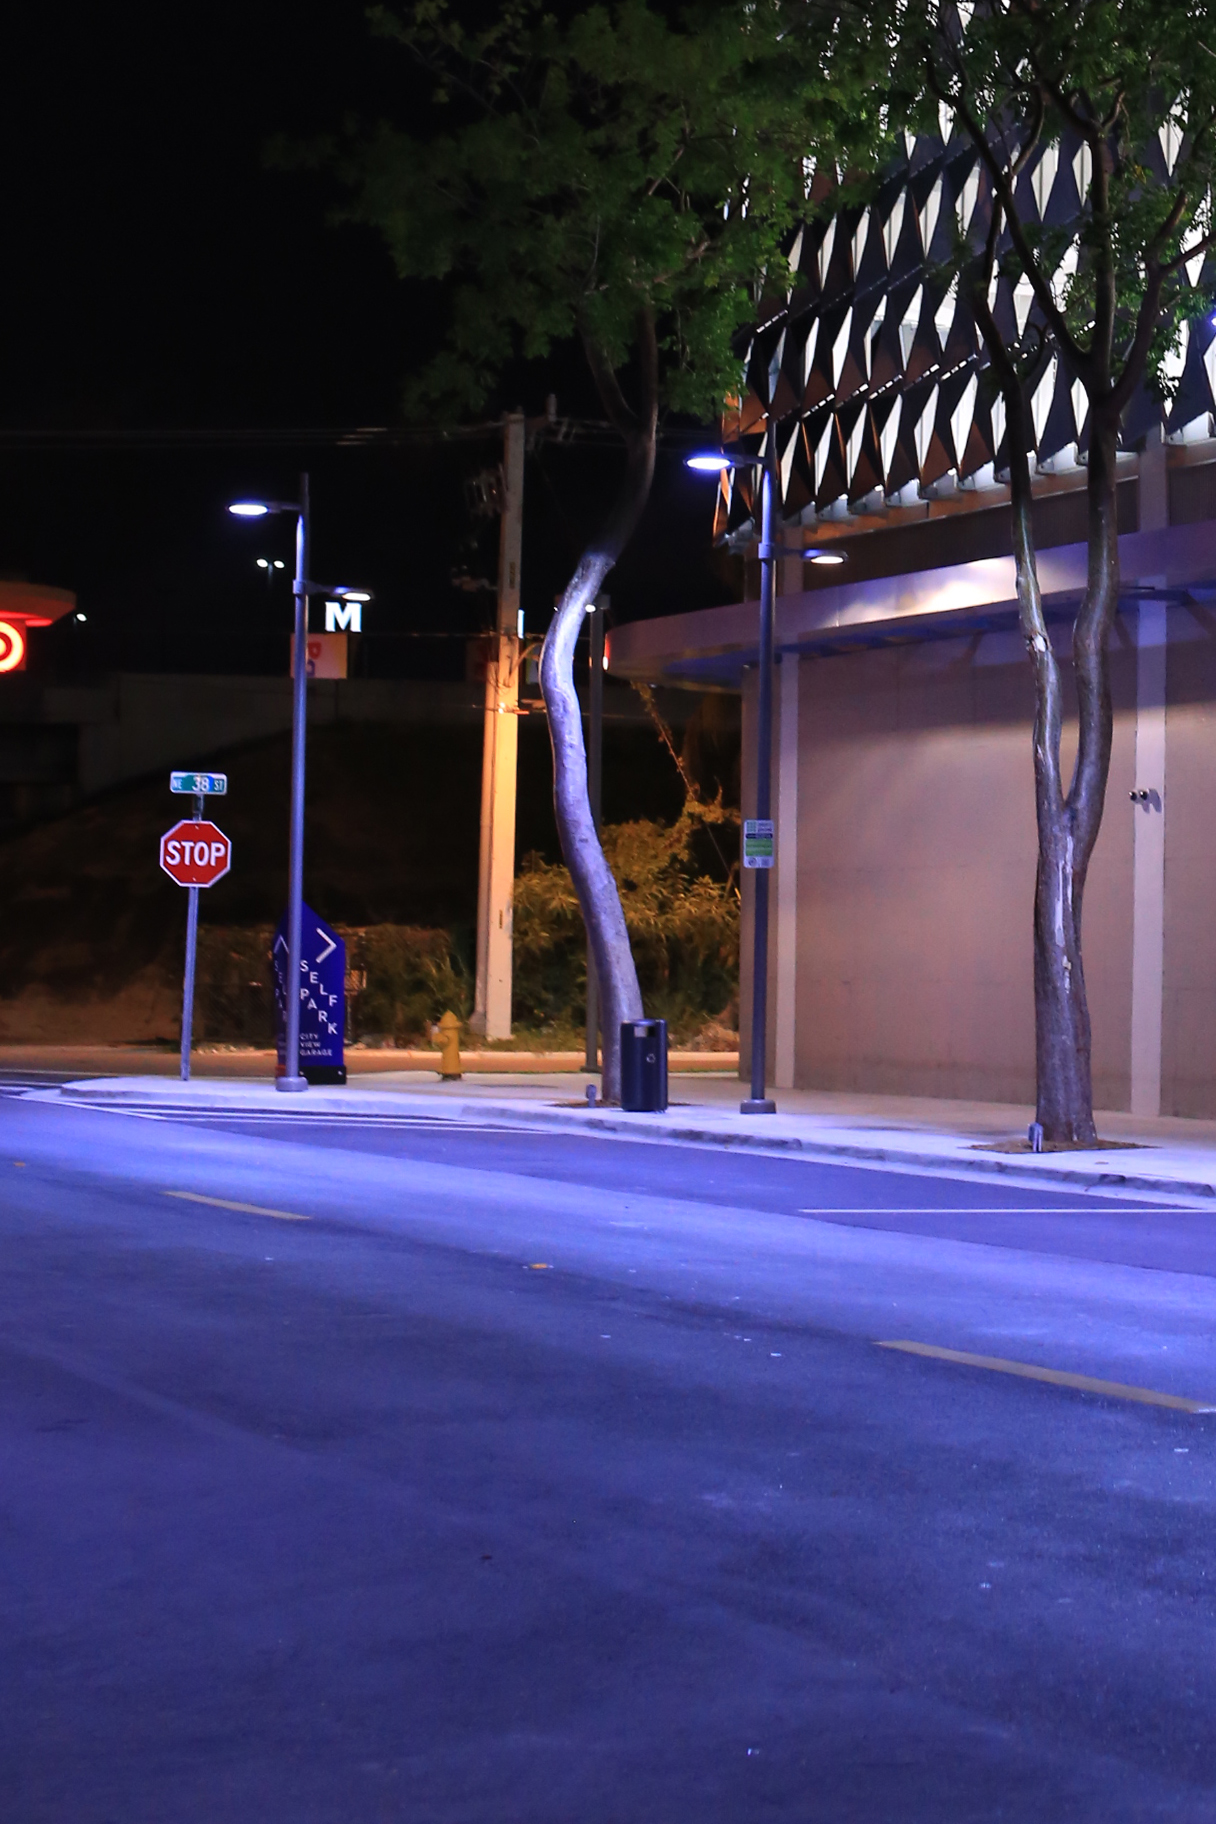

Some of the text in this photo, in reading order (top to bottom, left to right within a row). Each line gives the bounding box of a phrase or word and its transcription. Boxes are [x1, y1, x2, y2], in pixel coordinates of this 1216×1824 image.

[325, 601, 362, 633] M
[172, 776, 224, 791] NE 38 ST
[165, 839, 227, 866] STOP
[300, 959, 338, 1007] SELF
[300, 988, 338, 1035] PARK
